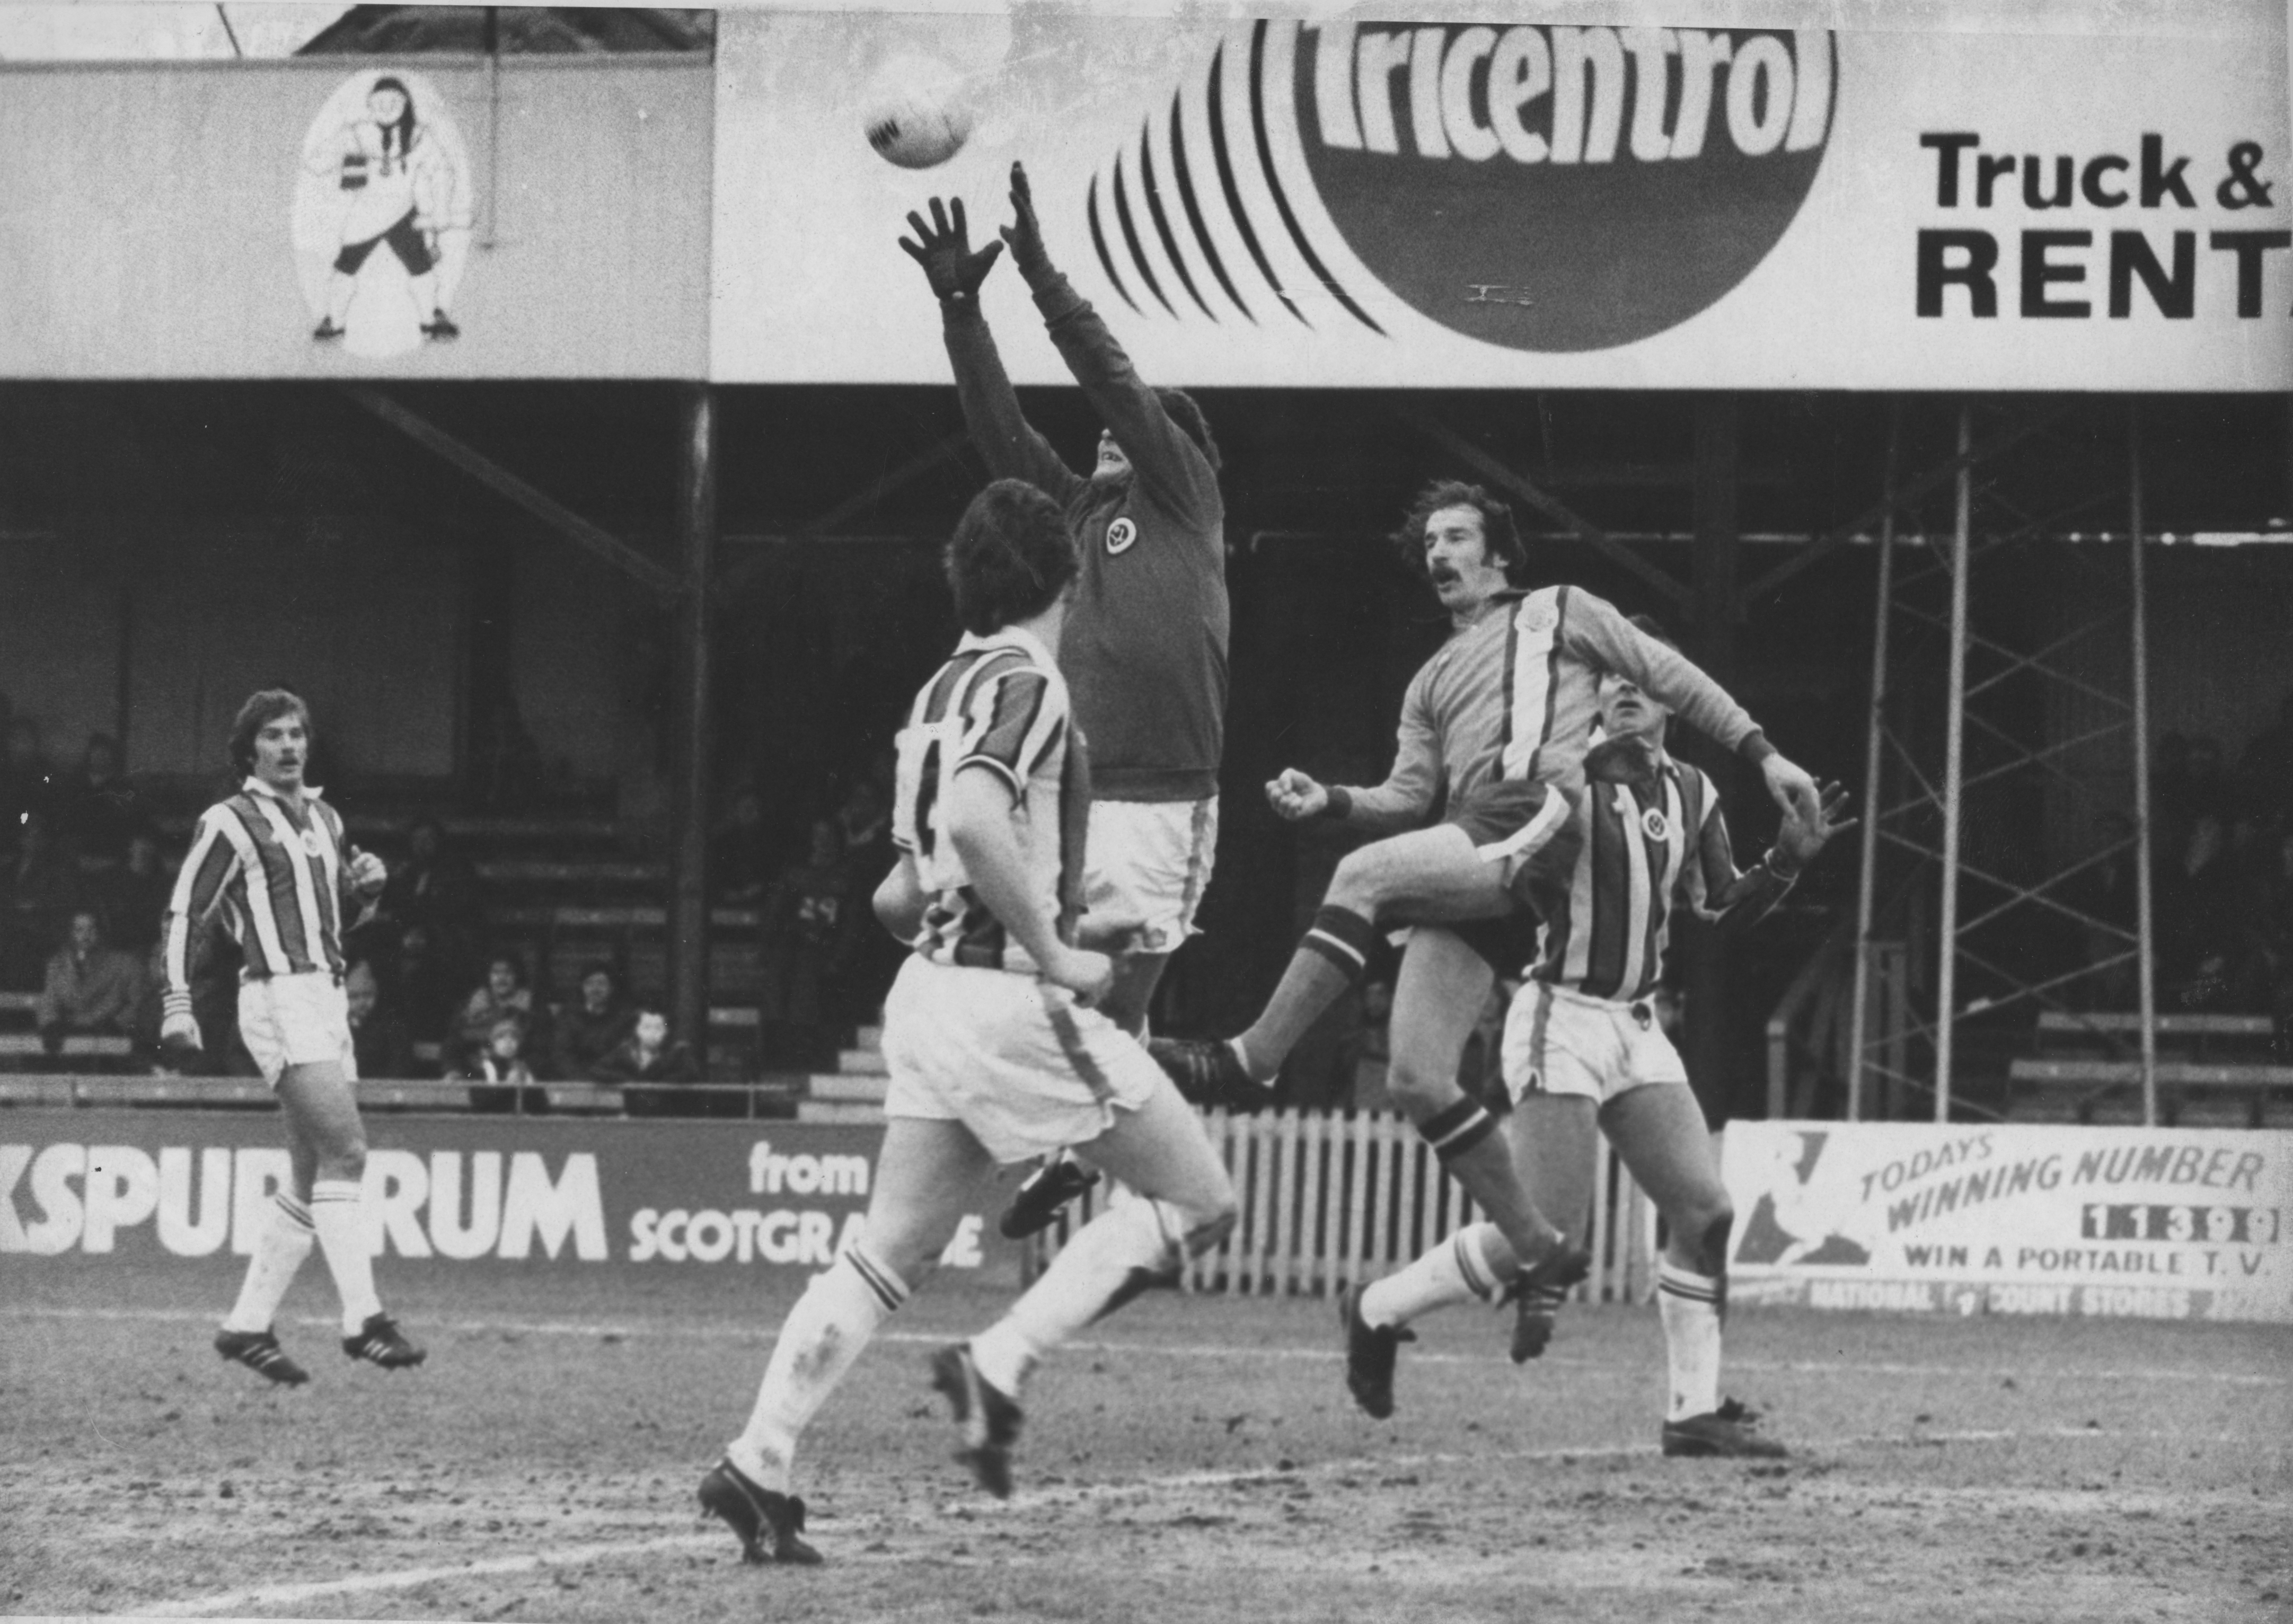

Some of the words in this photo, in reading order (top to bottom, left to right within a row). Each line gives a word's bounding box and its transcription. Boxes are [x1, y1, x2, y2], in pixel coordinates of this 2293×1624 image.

[1920, 132, 2197, 209] Truck
[2216, 140, 2274, 210] &
[749, 1141, 869, 1195] from
[1861, 1133, 1993, 1202] TODAYS
[1888, 1153, 2062, 1233] WINNING
[2071, 1145, 2265, 1191] NUMBER
[366, 1149, 608, 1262] RUM
[1905, 1245, 1968, 1268] WIN
[1983, 1246, 2003, 1269] A
[2017, 1247, 2184, 1275] PORTABLE
[1810, 1281, 1934, 1311] NATIONAL
[2082, 1284, 2190, 1318] STORES
